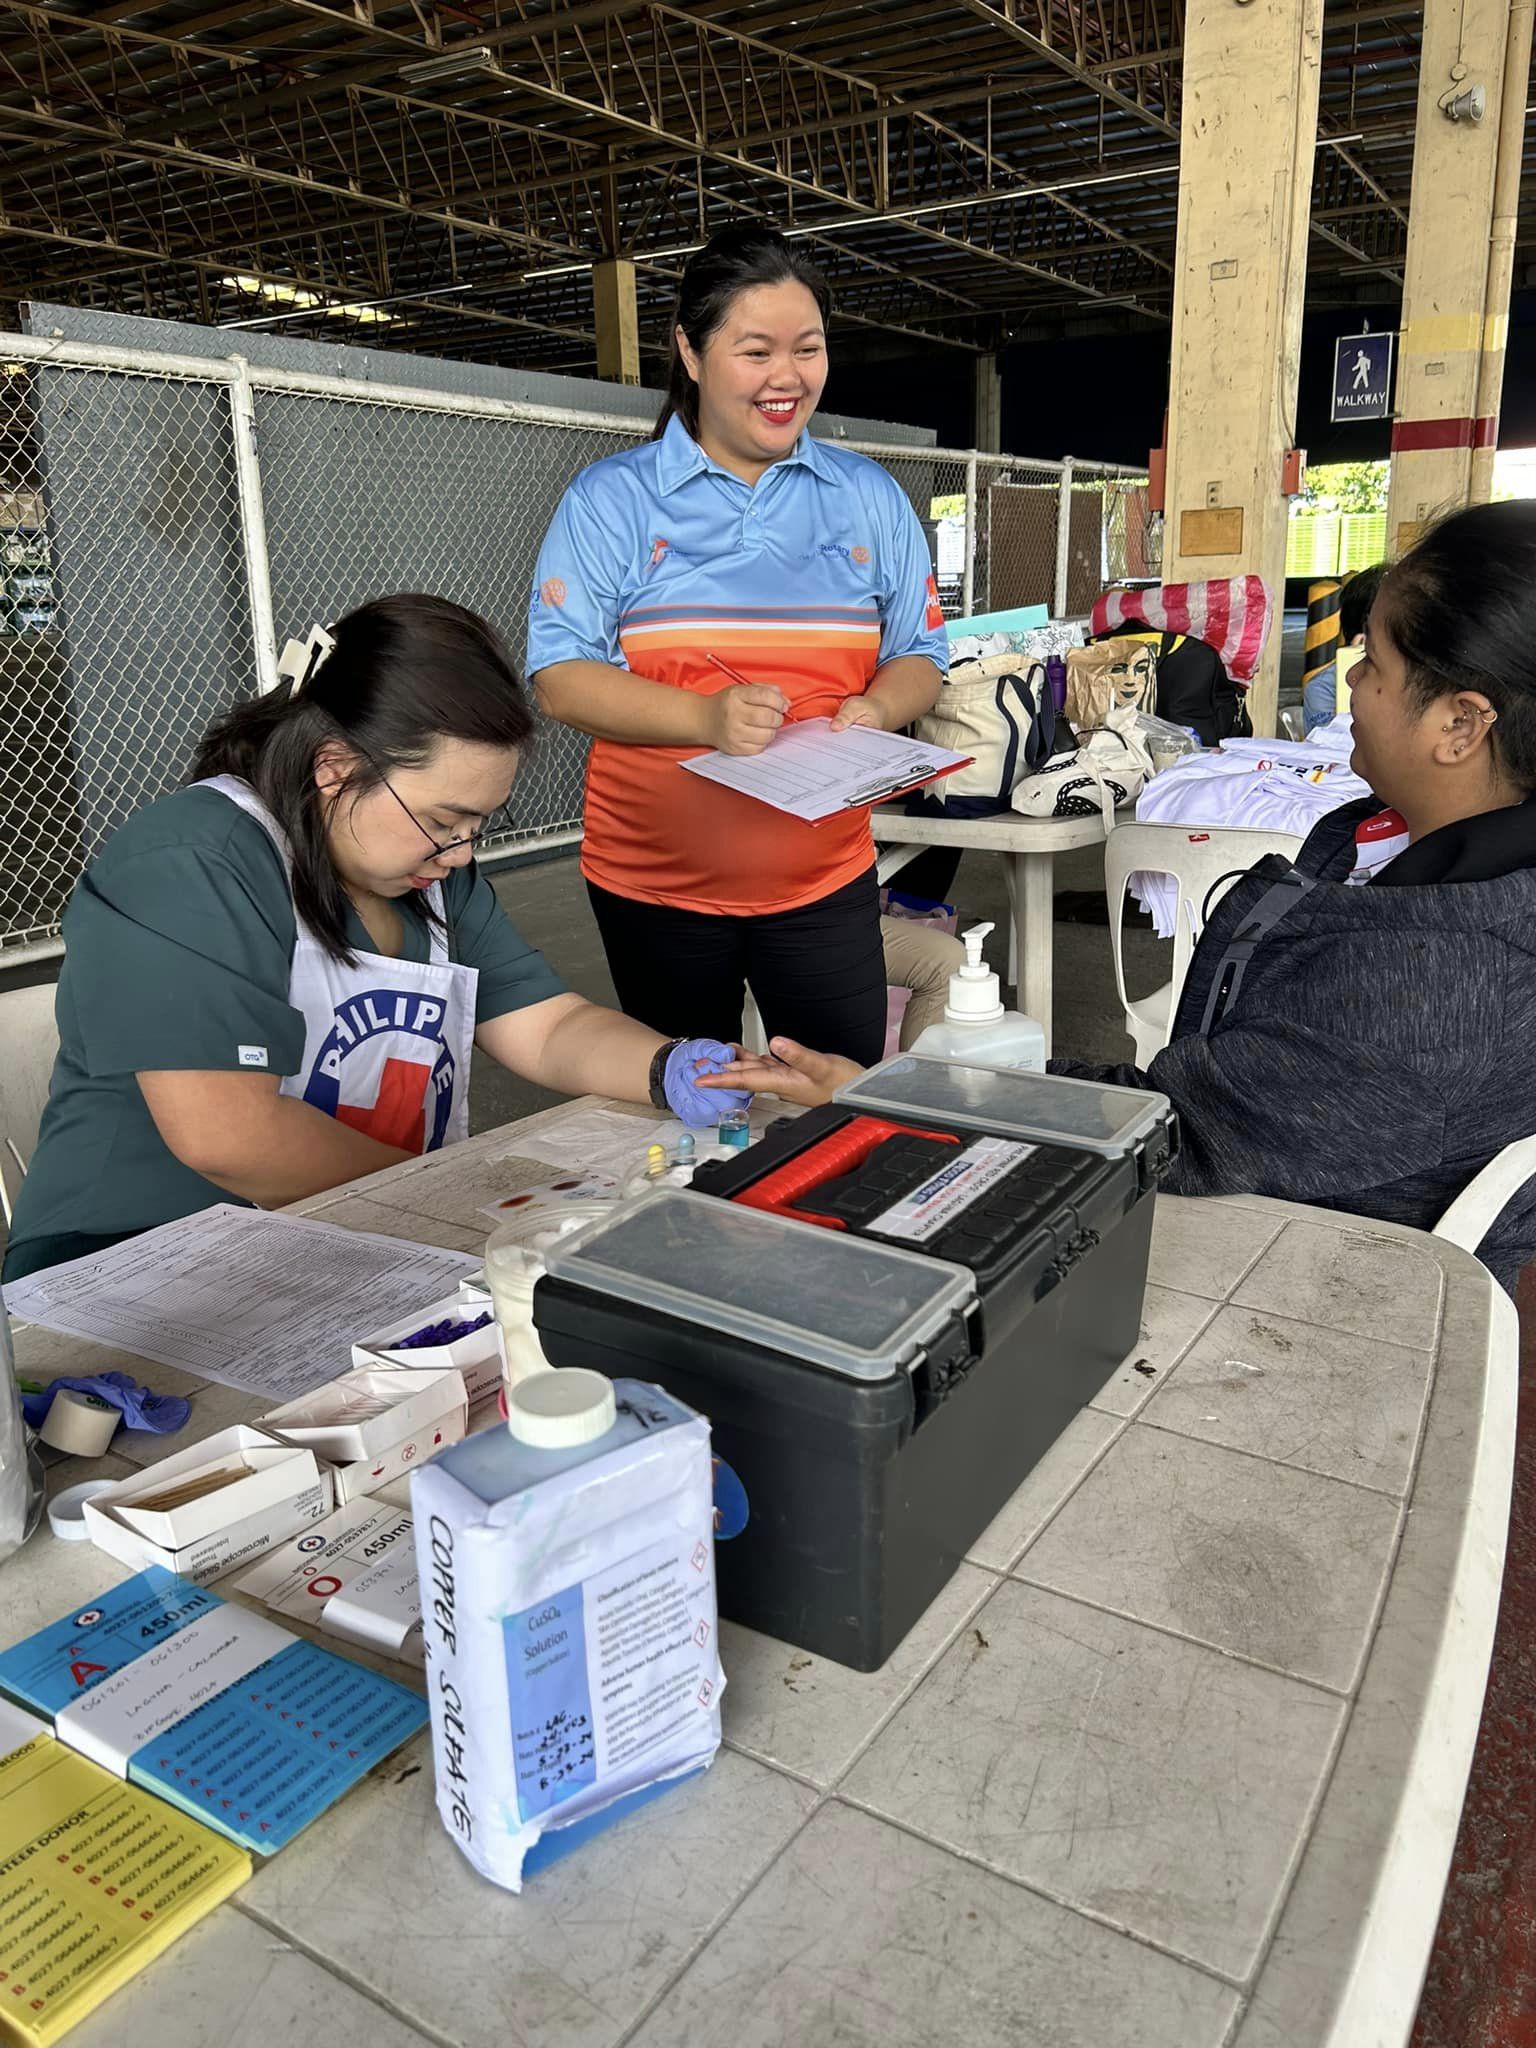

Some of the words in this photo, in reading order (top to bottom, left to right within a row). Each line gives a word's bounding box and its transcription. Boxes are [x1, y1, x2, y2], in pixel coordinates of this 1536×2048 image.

[1336, 391, 1386, 407] WALKWAY
[820, 543, 850, 557] Rotary
[312, 1502, 325, 1518] 72
[221, 1534, 270, 1566] Microscope
[307, 1576, 342, 1597] O
[363, 1519, 413, 1558] 450ml
[303, 1567, 317, 1576] O
[70, 1660, 108, 1687] A
[140, 1595, 208, 1638] 450ml
[524, 1628, 568, 1661] Solution
[69, 1646, 85, 1657] A
[164, 1687, 230, 1735] VOLUNTEER
[231, 1659, 274, 1689] DONOR
[250, 1693, 260, 1702] A
[265, 1702, 274, 1711] A
[280, 1710, 290, 1720] A
[296, 1719, 305, 1728] A
[312, 1729, 322, 1738] A
[329, 1740, 339, 1749] A
[348, 1749, 358, 1758] A
[160, 1758, 169, 1767] A
[175, 1768, 184, 1776] A
[190, 1777, 200, 1786] A
[206, 1788, 215, 1796] A
[222, 1798, 232, 1808] A
[239, 1811, 249, 1820] A
[40, 1809, 90, 1848] DONOR
[260, 1821, 270, 1830] A
[57, 1853, 70, 1864] B
[72, 1864, 86, 1875] B
[88, 1874, 101, 1886] B
[105, 1885, 118, 1897] B
[122, 1897, 135, 1909] B
[140, 1910, 154, 1921] B
[12, 1985, 26, 1996] B
[30, 2000, 44, 2010] B
